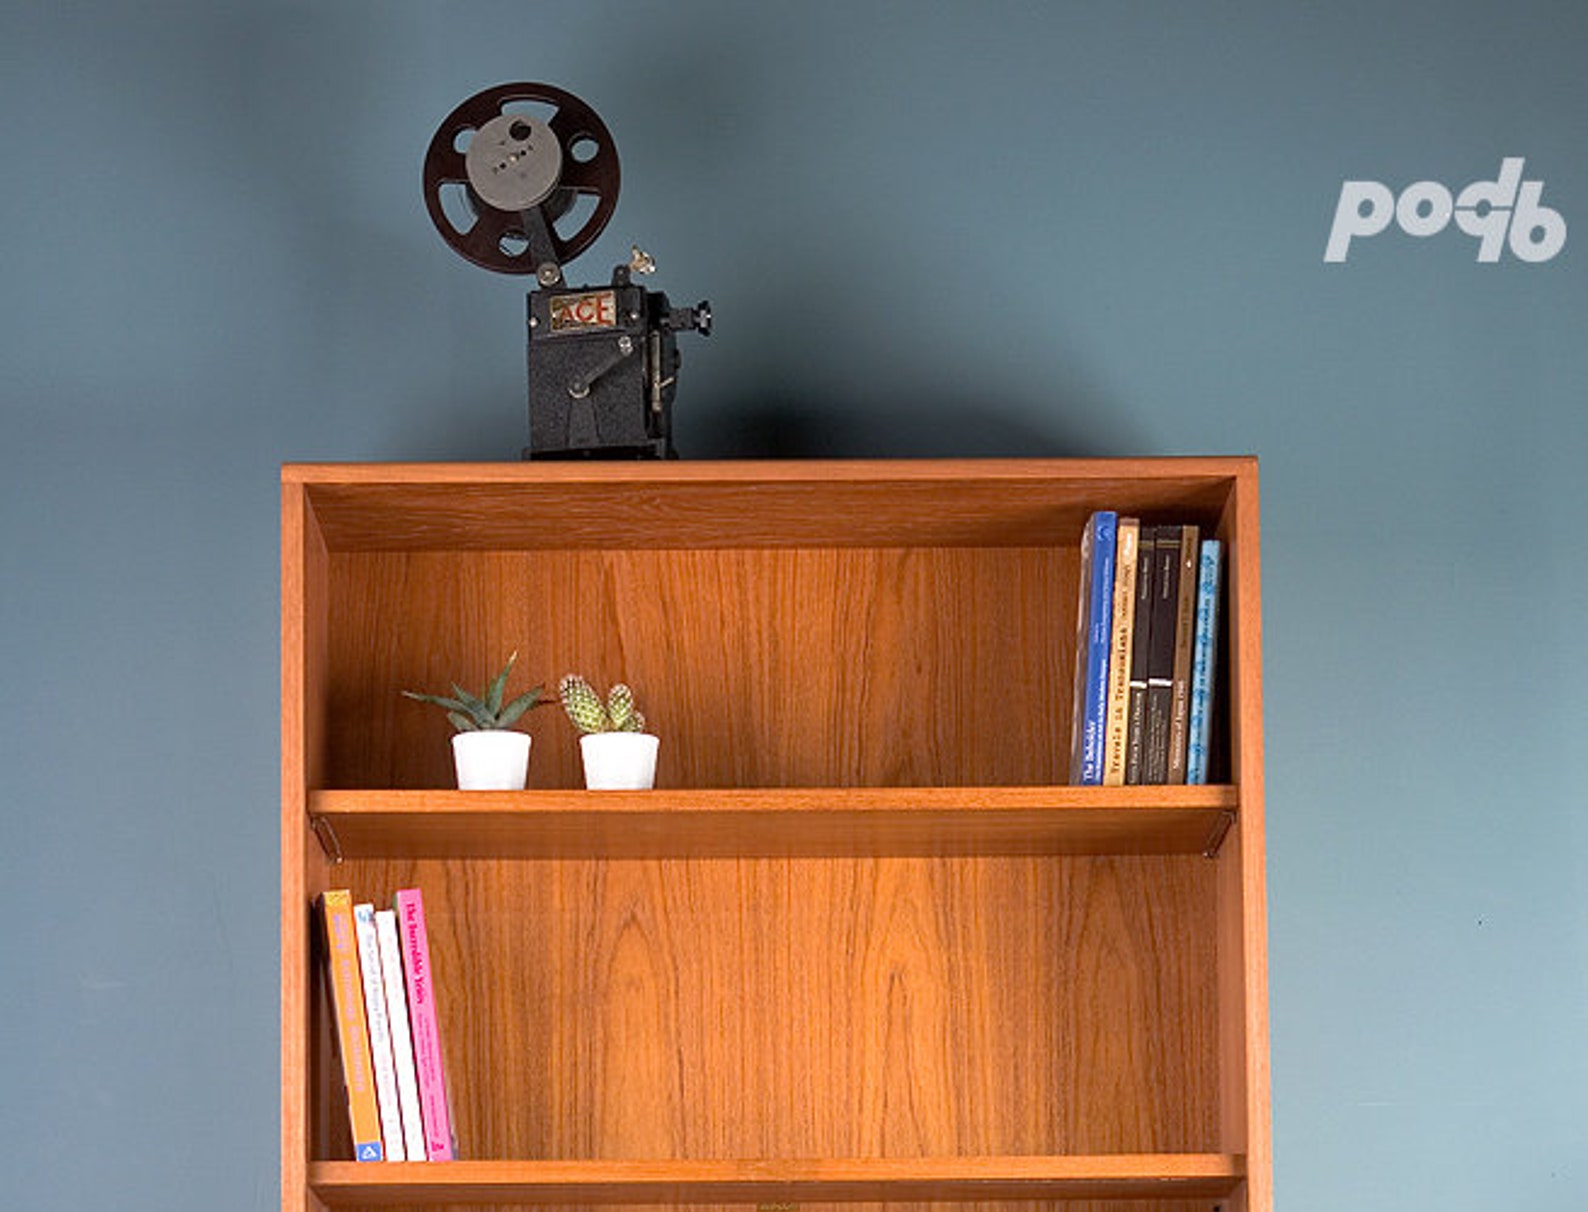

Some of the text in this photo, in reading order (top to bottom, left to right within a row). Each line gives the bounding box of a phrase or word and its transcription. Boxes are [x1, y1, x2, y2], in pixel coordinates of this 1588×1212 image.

[561, 291, 613, 325] ACE
[1111, 727, 1123, 774] Travels
[1083, 762, 1095, 781] The
[406, 903, 425, 1004] The Incredible Years
